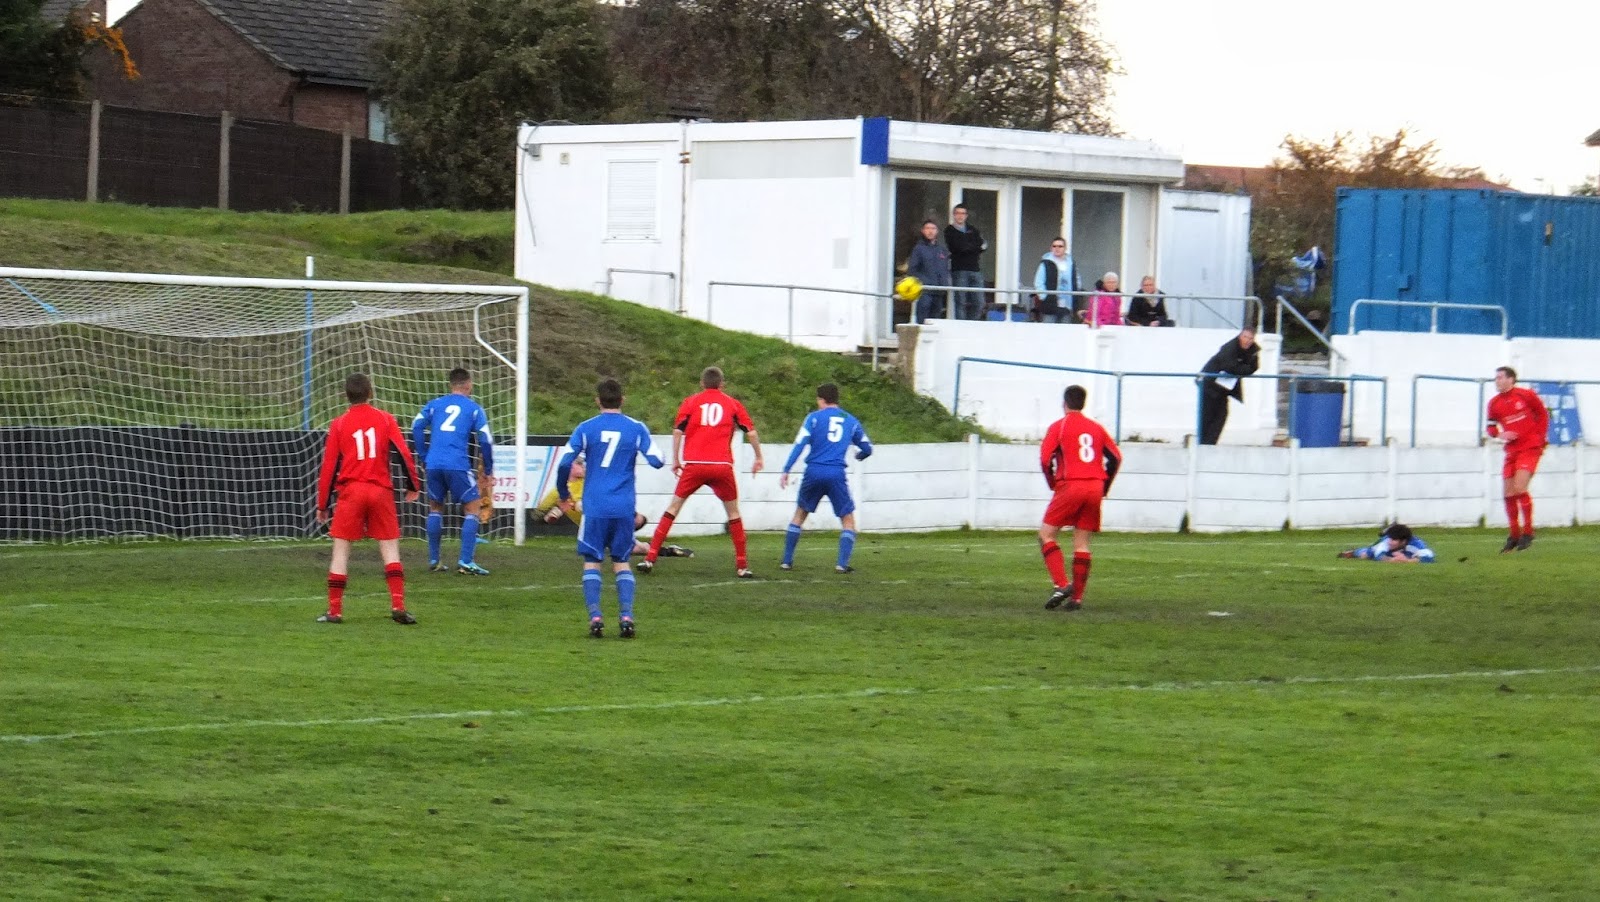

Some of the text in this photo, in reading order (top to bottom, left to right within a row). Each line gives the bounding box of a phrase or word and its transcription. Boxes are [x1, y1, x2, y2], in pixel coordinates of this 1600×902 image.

[439, 404, 462, 432] 2
[699, 402, 724, 427] 10
[827, 416, 845, 443] 5
[351, 426, 377, 461] 11
[600, 430, 622, 468] 7
[1077, 432, 1096, 464] 8
